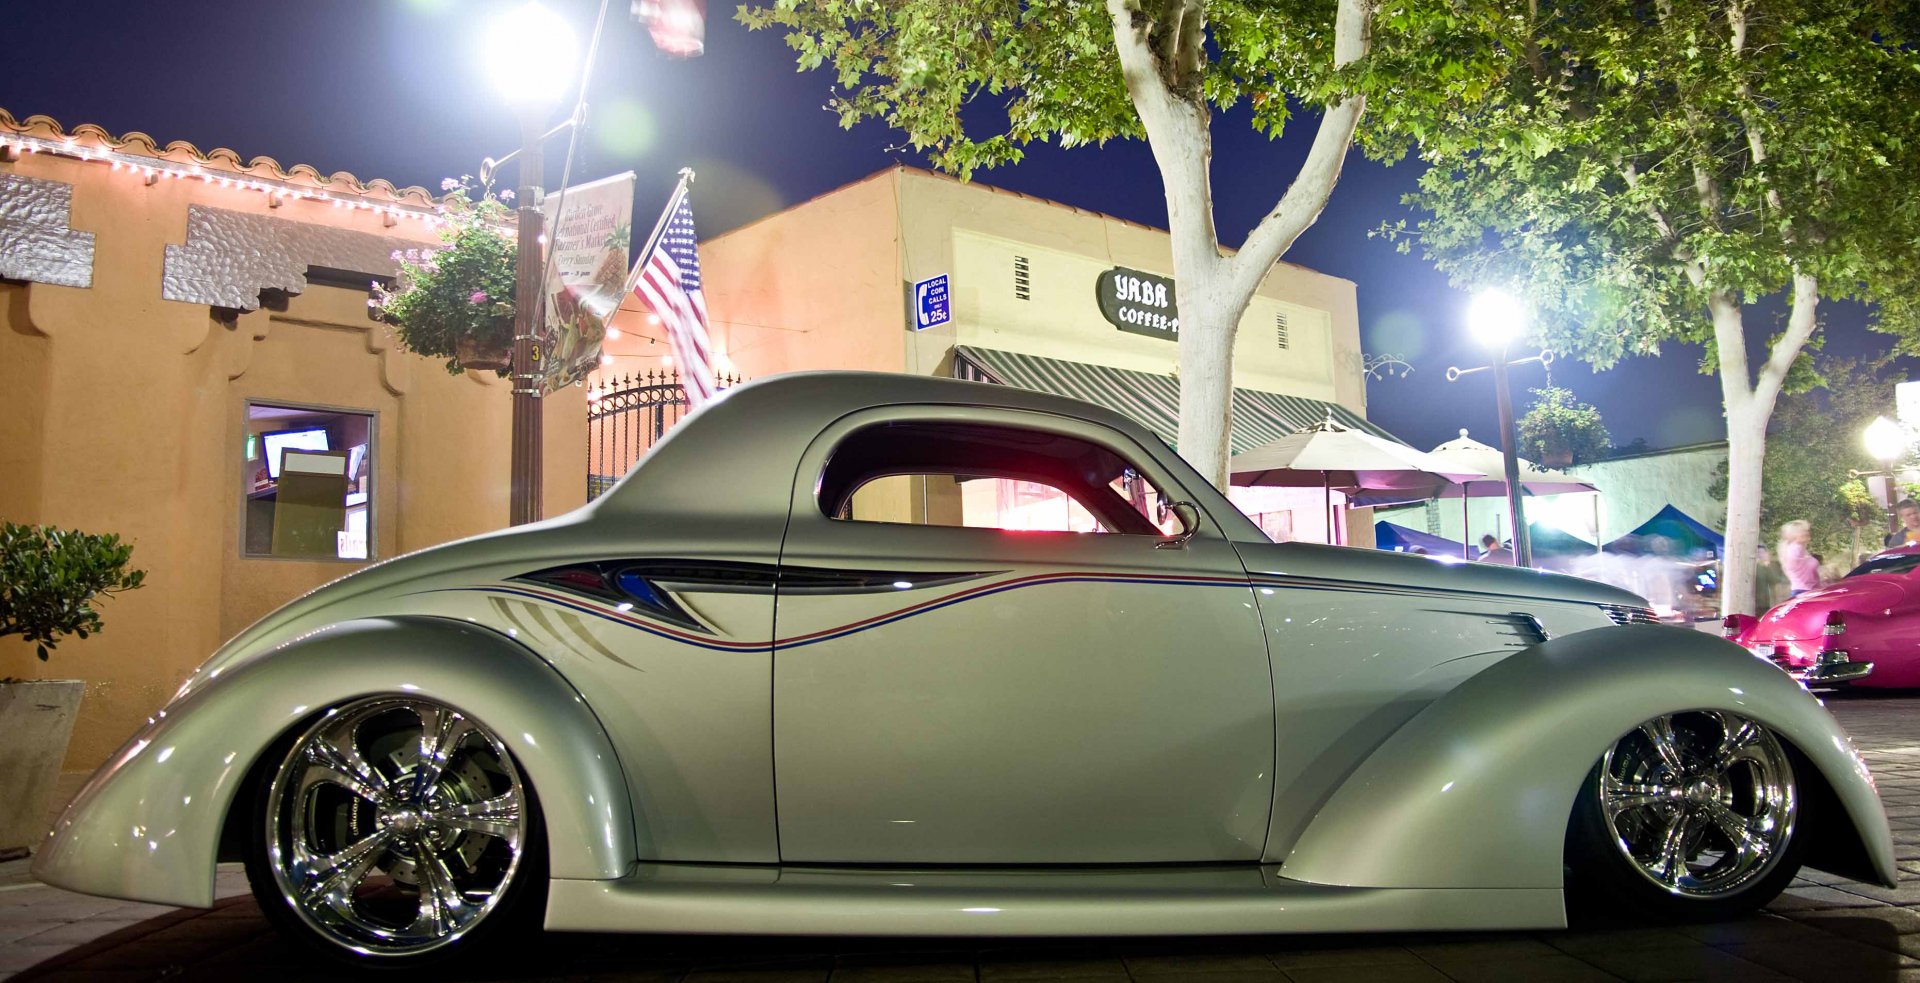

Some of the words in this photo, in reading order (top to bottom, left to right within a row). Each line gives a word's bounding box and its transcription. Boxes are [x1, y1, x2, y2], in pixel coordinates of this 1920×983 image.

[584, 231, 606, 249] Marke
[928, 278, 946, 288] LOCAL
[931, 286, 944, 295] COIN
[1114, 274, 1168, 308] YABA
[929, 294, 947, 304] CALLS
[930, 309, 947, 322] 25¢
[532, 345, 540, 361] 3
